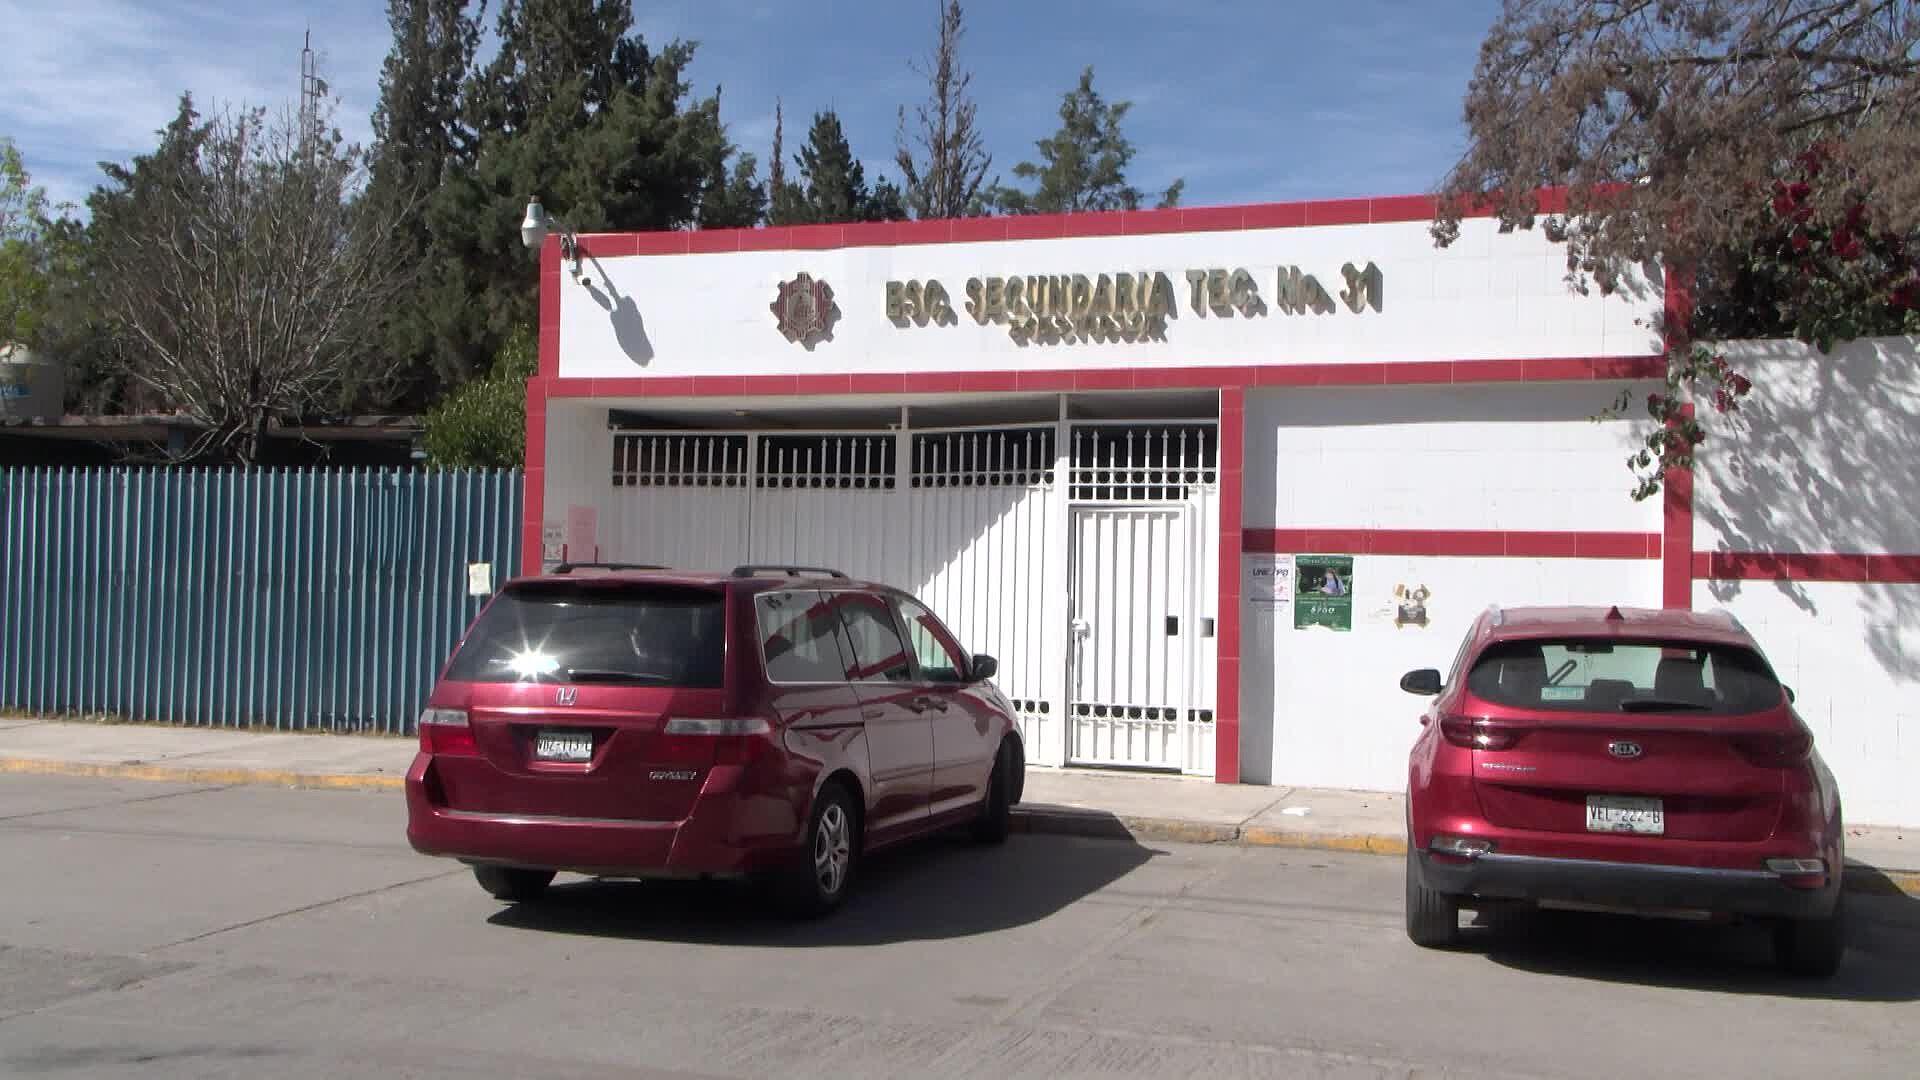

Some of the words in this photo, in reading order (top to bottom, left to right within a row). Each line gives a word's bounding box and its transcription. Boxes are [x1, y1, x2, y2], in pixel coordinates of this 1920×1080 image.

[886, 279, 958, 327] ESC.
[1186, 267, 1267, 319] TEC.
[1277, 265, 1336, 315] No.
[1339, 261, 1383, 313] 31
